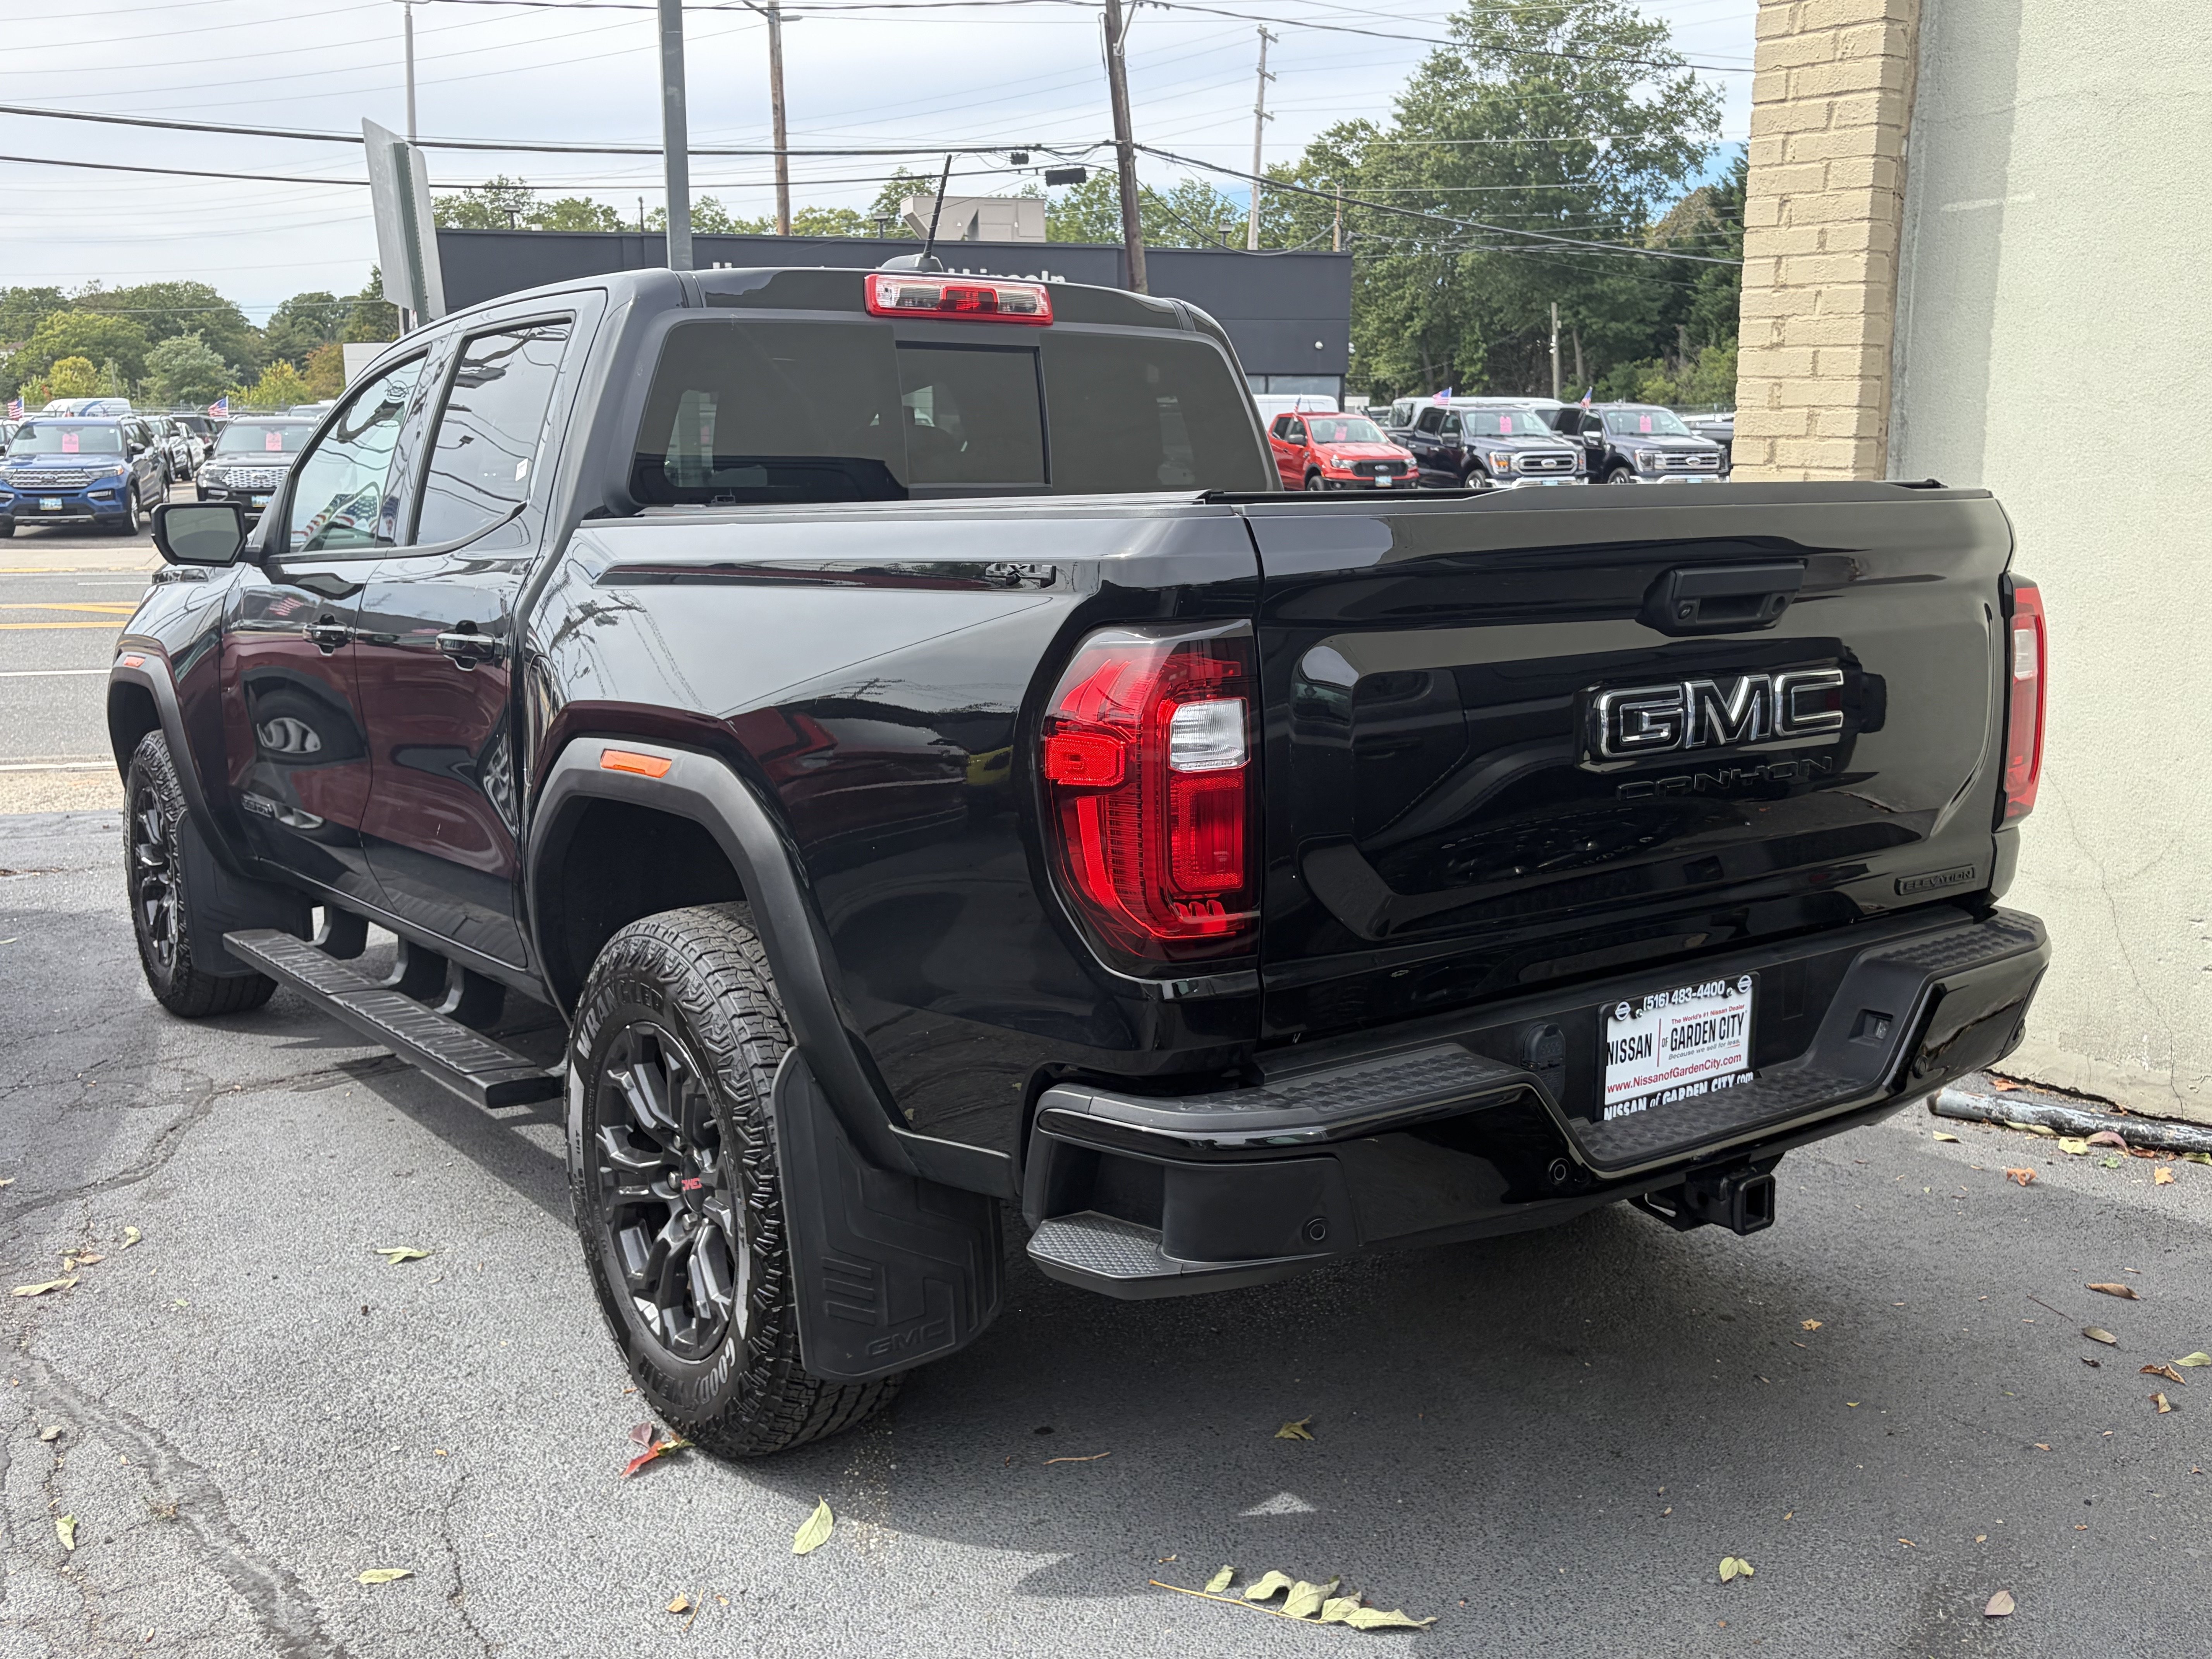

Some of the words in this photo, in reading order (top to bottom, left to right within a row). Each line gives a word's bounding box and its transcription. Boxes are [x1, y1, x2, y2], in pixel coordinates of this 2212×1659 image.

[1597, 668, 1844, 758] GMC
[1616, 756, 1832, 802] CANYON
[1904, 871, 1970, 890] ELEVATION
[1644, 992, 1669, 1011] (516)
[1671, 980, 1725, 1004] 483-4400
[1683, 1013, 1702, 1022] World's
[1729, 1004, 1745, 1012] Dealer
[1607, 1033, 1652, 1066] NISSAN
[1662, 1037, 1669, 1048] OF
[1670, 1018, 1716, 1051] GARDEN
[1719, 1012, 1744, 1040] CITY
[1668, 1050, 1694, 1060] Because
[1607, 1054, 1741, 1093] www.NissanofGardenCity.com
[1604, 1097, 1647, 1121] NISSAN
[1650, 1092, 1661, 1108] of
[1662, 1081, 1708, 1105] GARDEN
[866, 1319, 945, 1358] GMC
